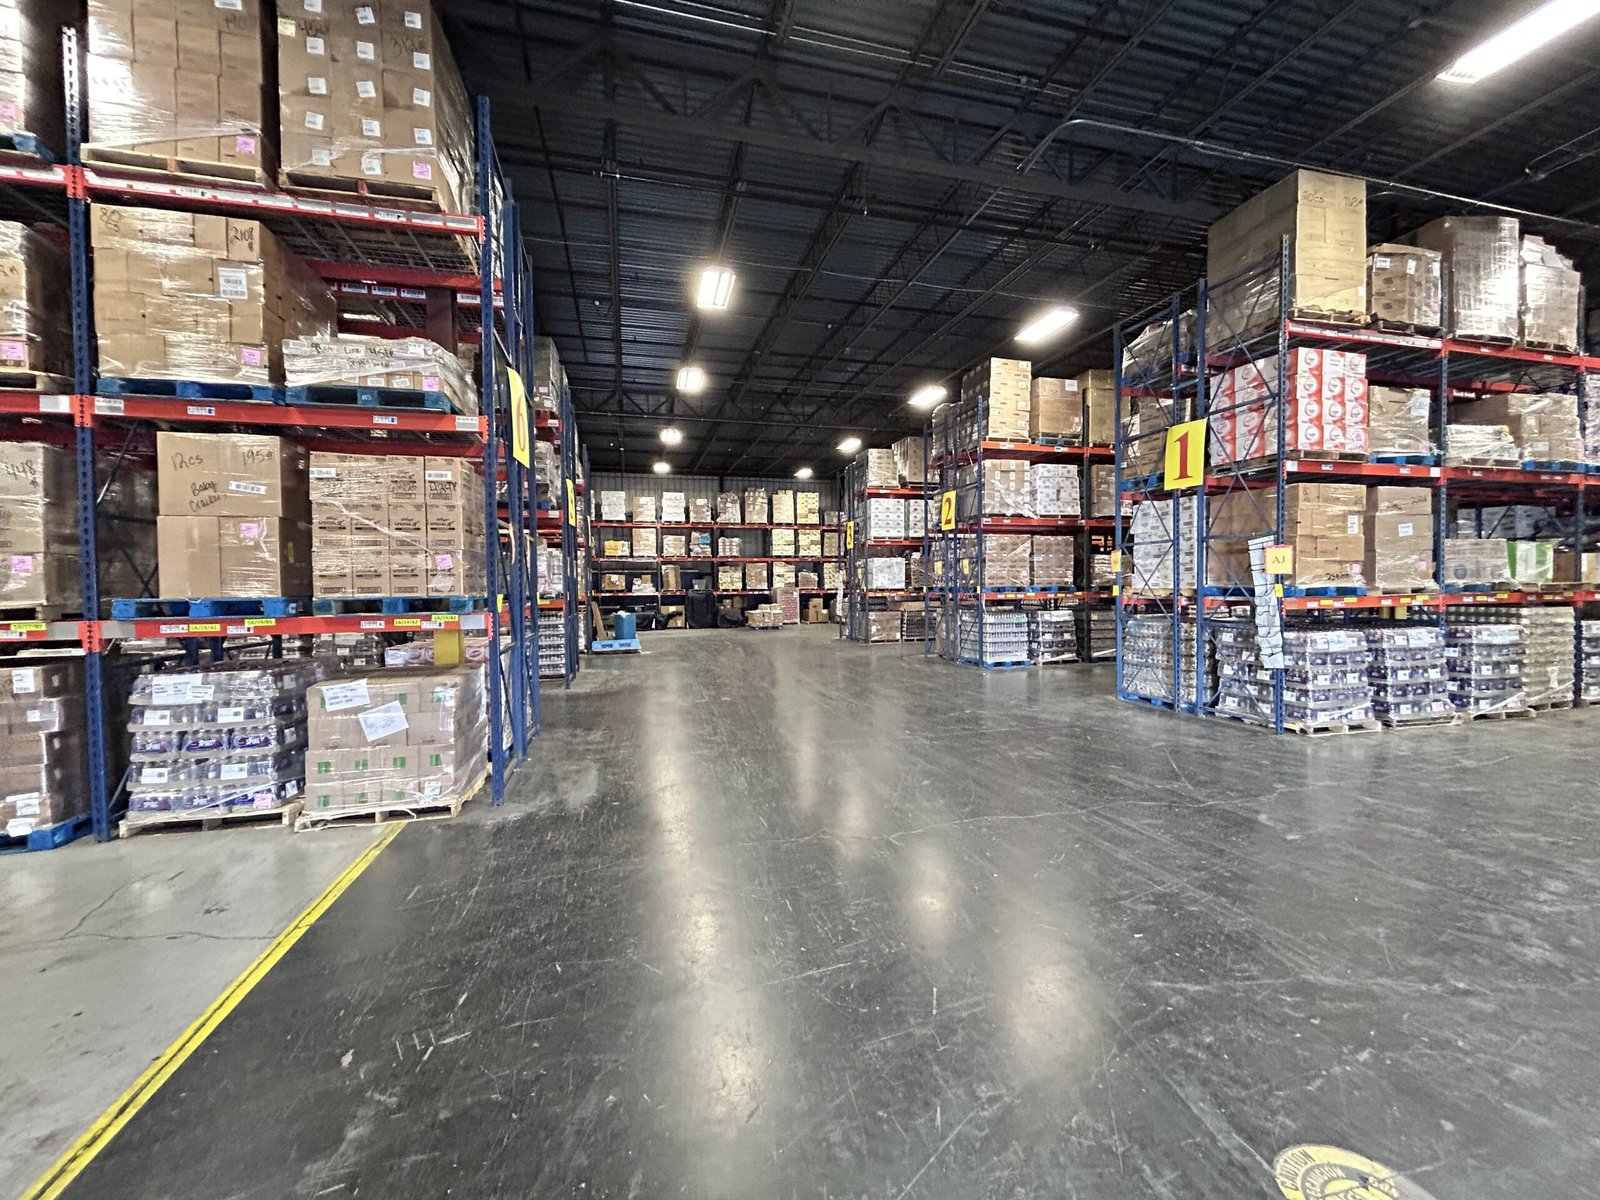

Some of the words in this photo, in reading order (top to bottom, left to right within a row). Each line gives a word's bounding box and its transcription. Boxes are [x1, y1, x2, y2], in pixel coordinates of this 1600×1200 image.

[517, 394, 526, 452] 6
[5, 460, 36, 480] 448
[1173, 431, 1193, 481] 1
[190, 481, 218, 497] Baby
[944, 497, 952, 525] 2
[1281, 1149, 1316, 1192] CAUTION
